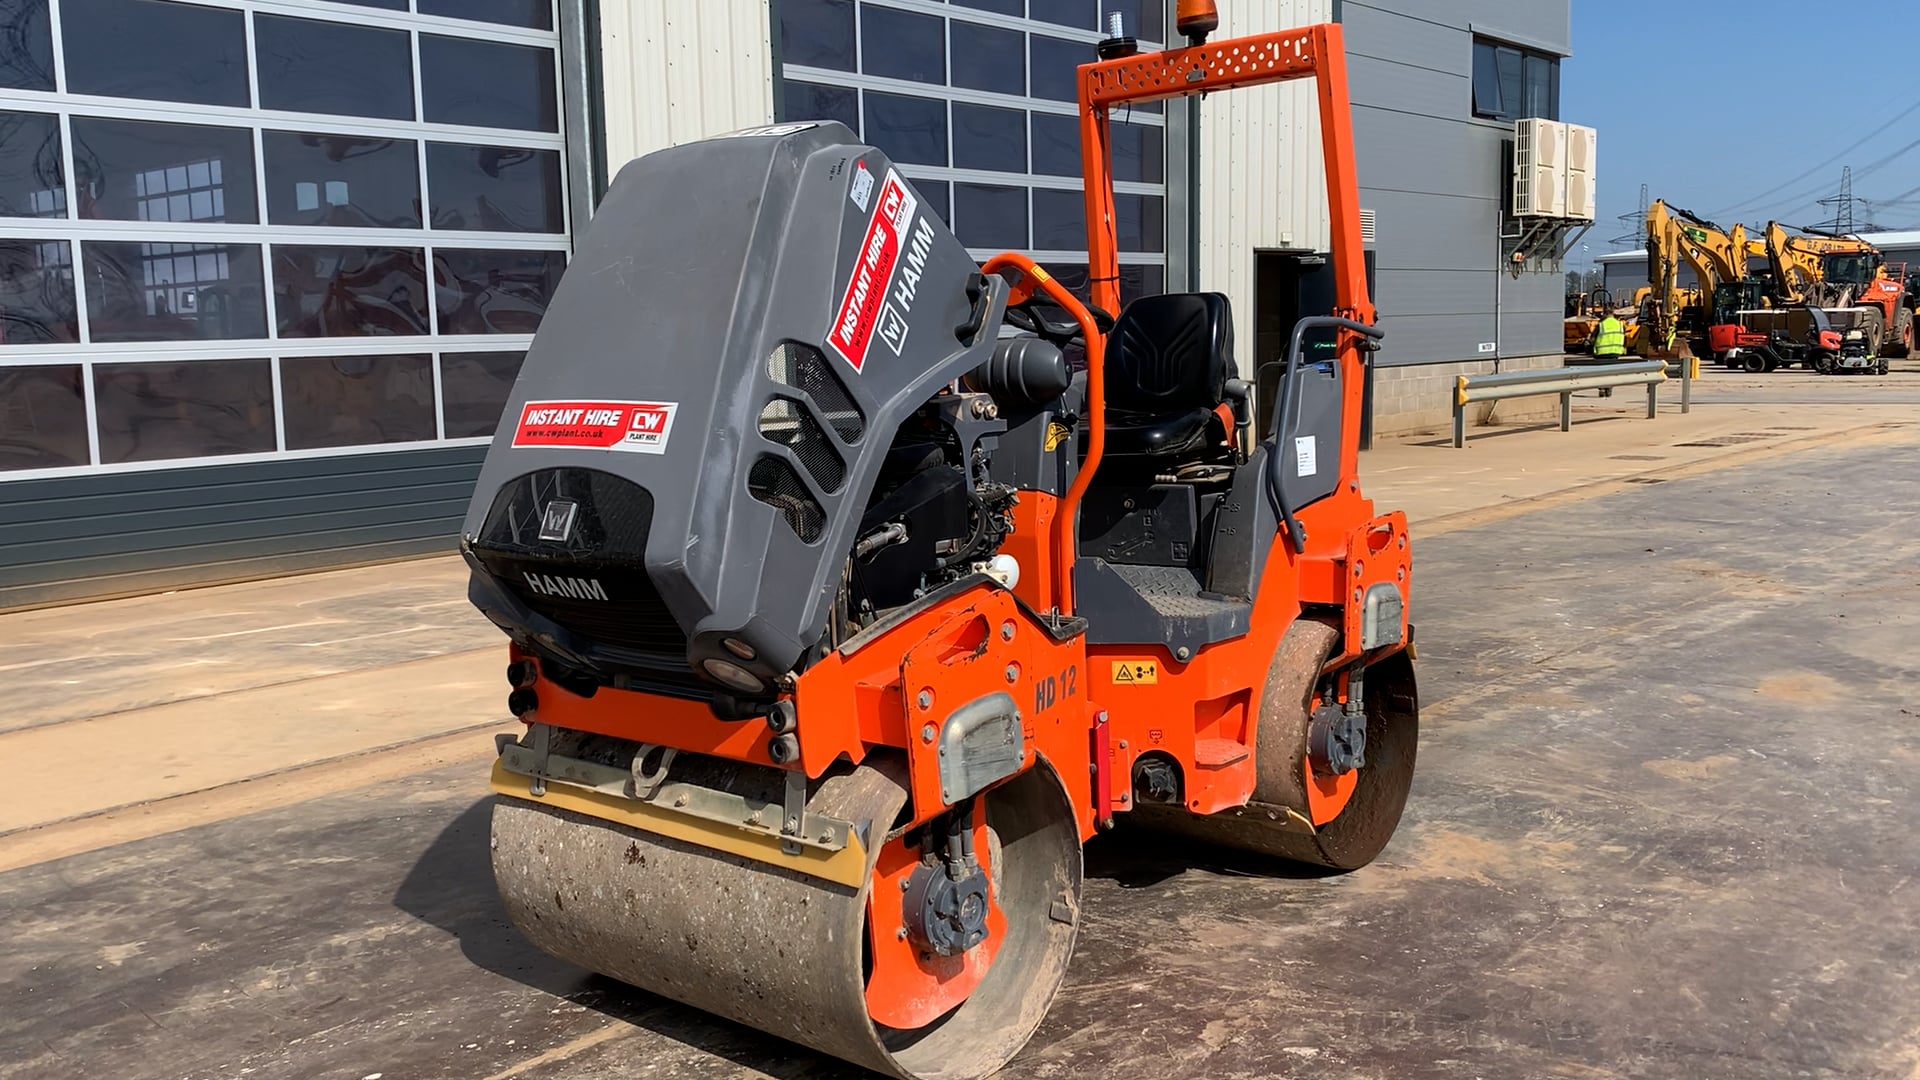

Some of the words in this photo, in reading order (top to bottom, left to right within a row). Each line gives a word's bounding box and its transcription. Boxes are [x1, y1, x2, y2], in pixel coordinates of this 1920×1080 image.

[884, 185, 900, 221] CW
[895, 216, 935, 312] HAMM
[839, 263, 872, 346] INSTANT
[866, 222, 887, 271] HIRE
[525, 409, 584, 426] INSTANT
[582, 409, 623, 427] HIRE
[526, 429, 604, 439] www.cwplant.co.uk
[632, 411, 662, 430] CW
[523, 571, 609, 601] HAMM
[1035, 675, 1056, 715] HD
[1060, 664, 1077, 700] 12
